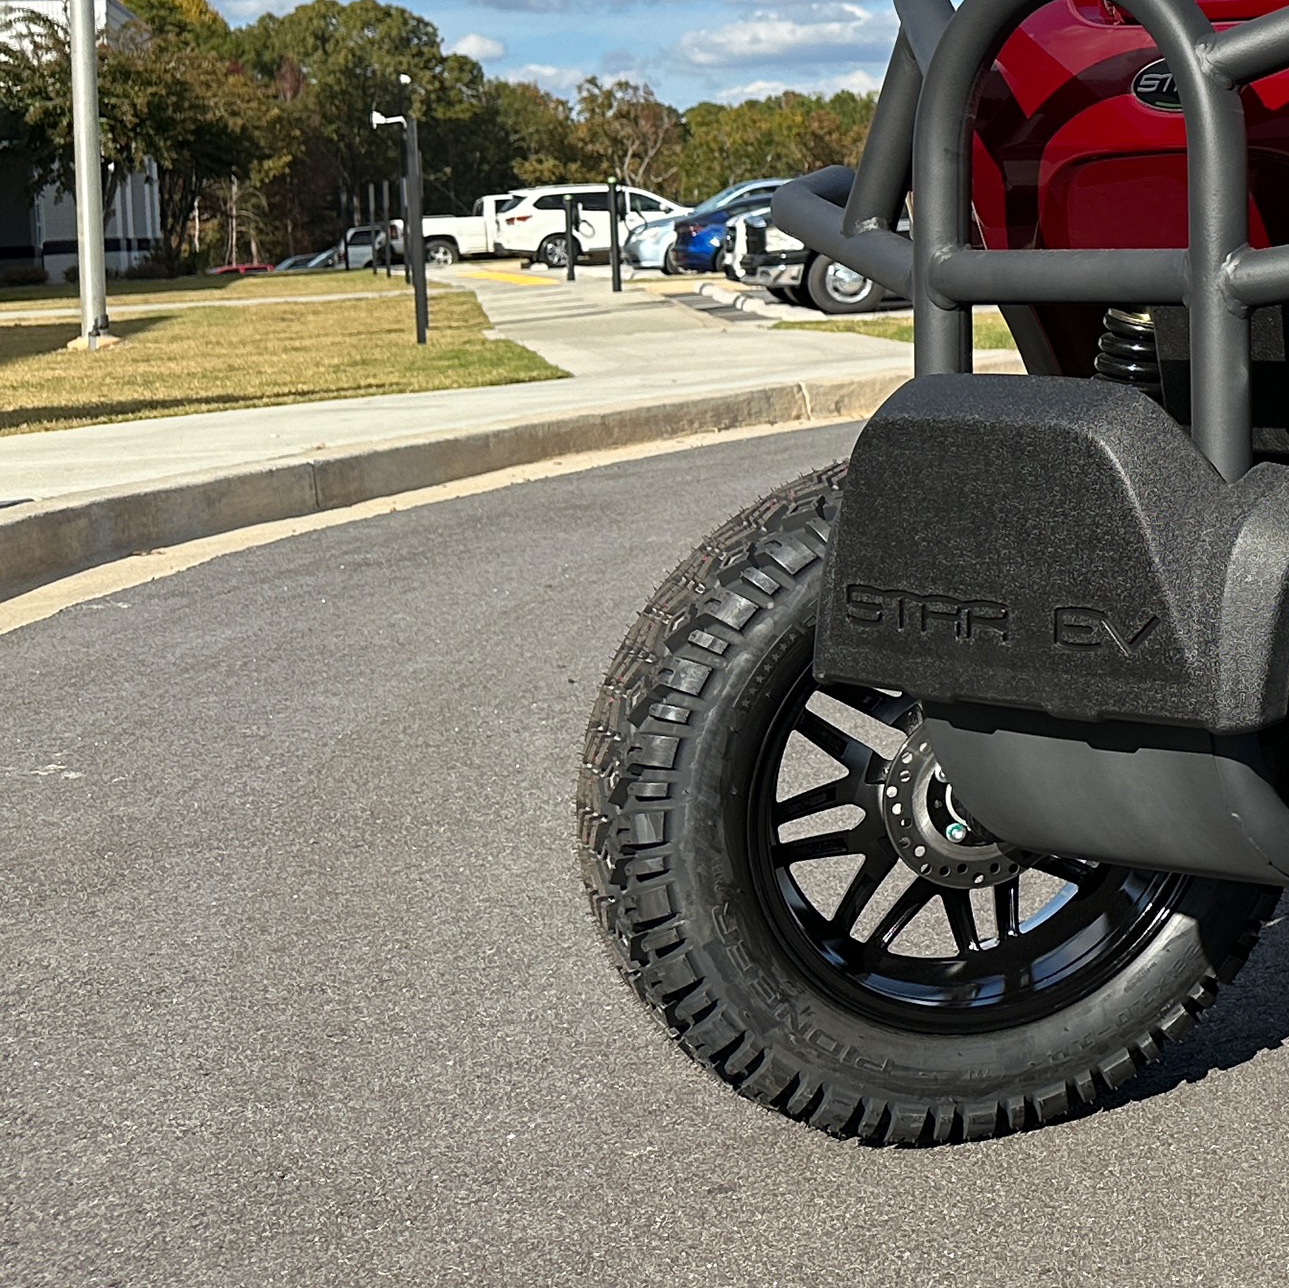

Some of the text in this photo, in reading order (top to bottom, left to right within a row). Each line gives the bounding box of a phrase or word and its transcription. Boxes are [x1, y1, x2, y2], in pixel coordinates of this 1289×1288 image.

[1137, 73, 1178, 93] ST
[846, 583, 1161, 658] STAR EV
